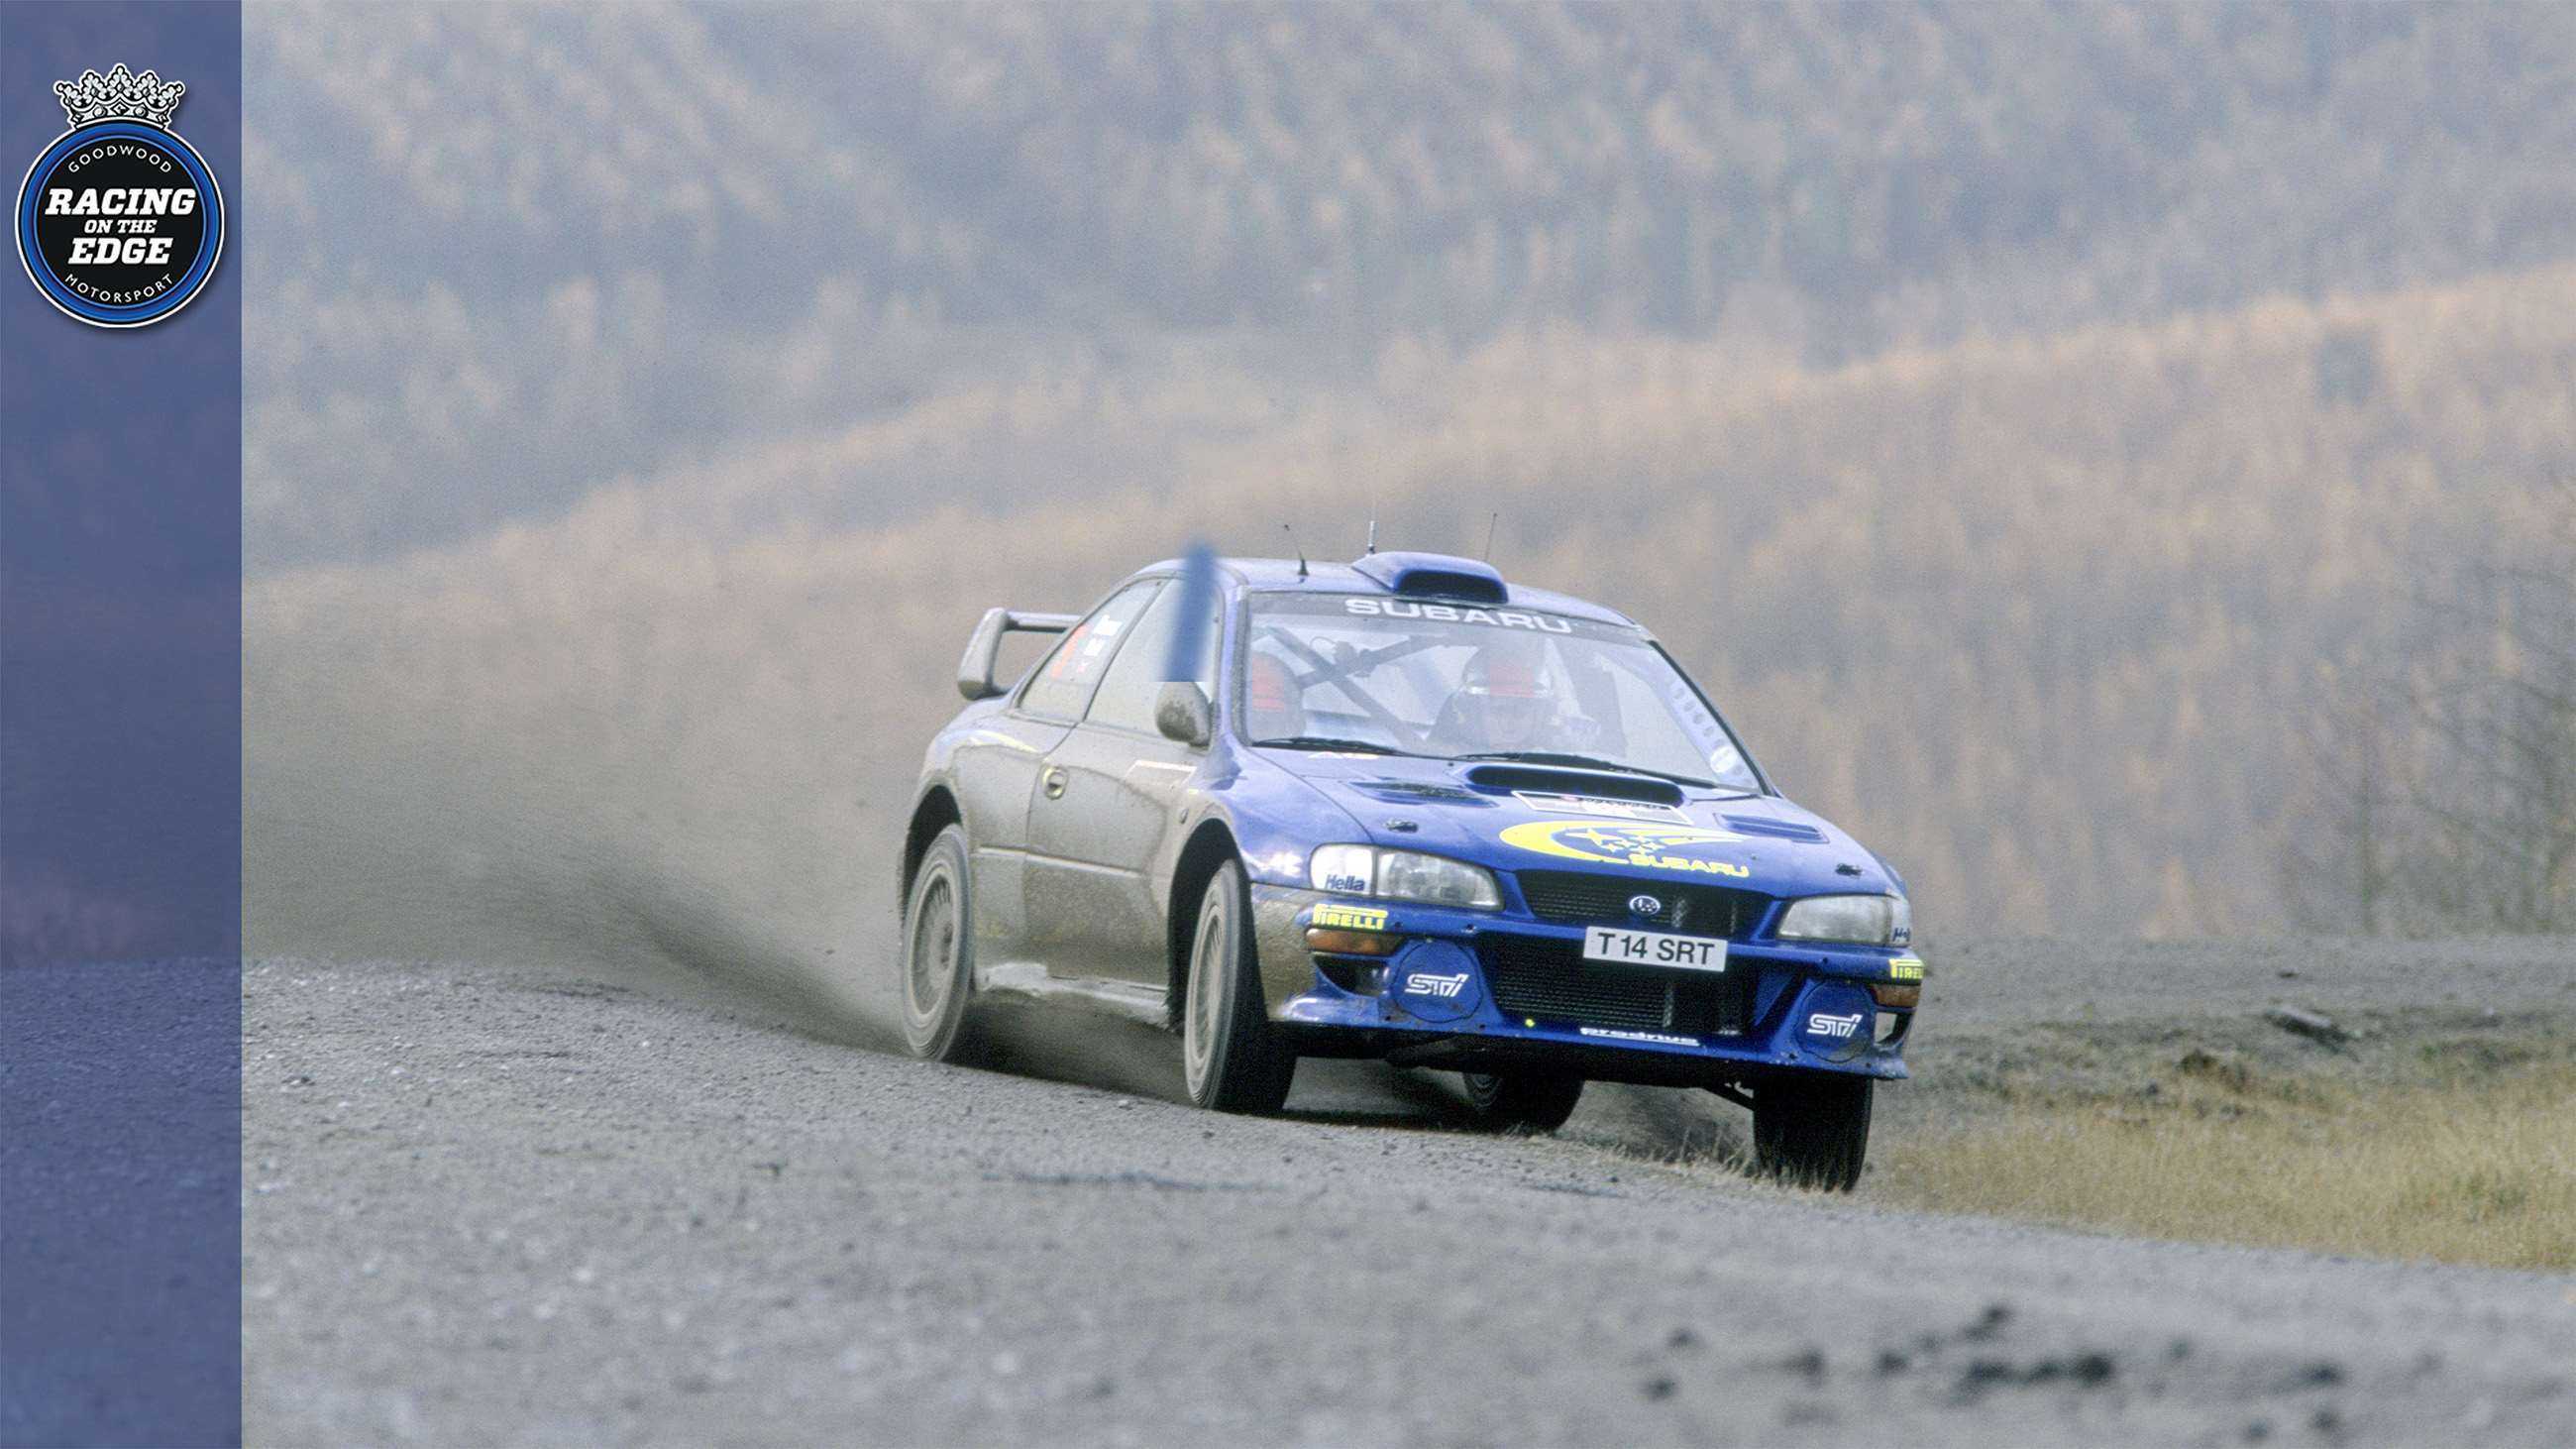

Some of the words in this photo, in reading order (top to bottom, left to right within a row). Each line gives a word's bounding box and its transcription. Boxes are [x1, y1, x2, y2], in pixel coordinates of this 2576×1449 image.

[1344, 599, 1572, 634] SUBARU
[1629, 853, 1751, 878] SUBARU
[1326, 874, 1366, 892] Hella
[1312, 903, 1389, 930] PIRELLI
[1597, 932, 1616, 955] T
[1620, 935, 1649, 959] 14
[1656, 938, 1716, 965] SRT
